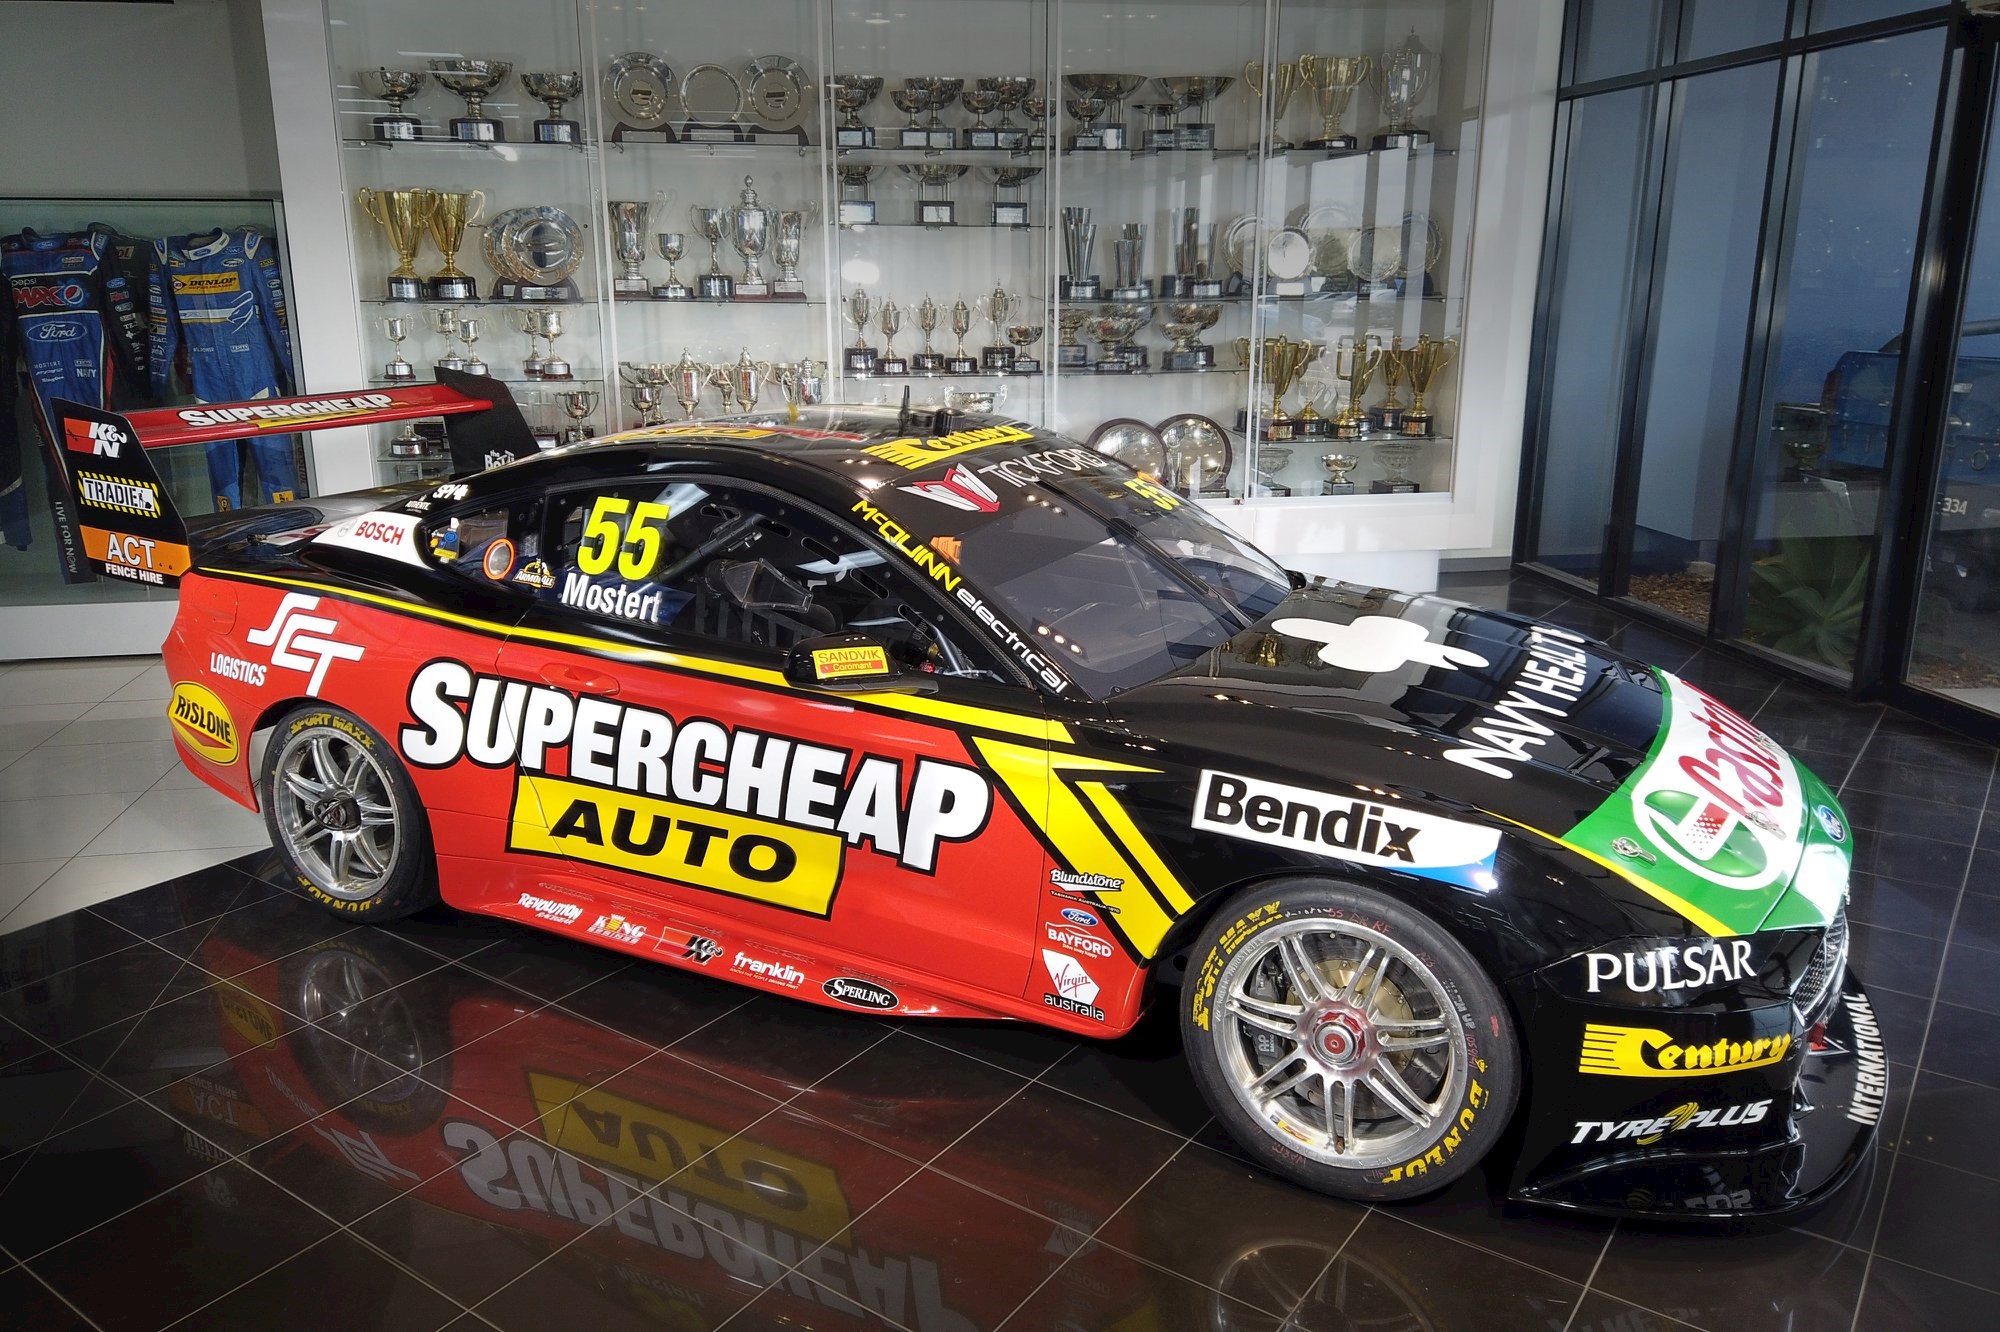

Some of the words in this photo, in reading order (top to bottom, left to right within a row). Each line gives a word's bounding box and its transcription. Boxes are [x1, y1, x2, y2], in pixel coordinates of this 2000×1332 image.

[11, 278, 37, 288] pepsi
[12, 285, 66, 309] MAX
[188, 277, 236, 287] DUNLOP
[39, 322, 77, 339] Ford
[76, 367, 97, 378] NAVY
[178, 394, 392, 427] SUPERCHEAP
[489, 449, 500, 457] the
[977, 449, 1108, 488] TICKFORD
[84, 479, 139, 509] TRADIE
[404, 500, 431, 510] AUTHENTIC
[54, 501, 67, 522] LIVE
[62, 524, 73, 546] FOR
[354, 521, 405, 546] BOSCH
[577, 496, 670, 581] 55
[106, 533, 155, 568] ACT
[104, 562, 139, 580] FENCE
[139, 569, 164, 585] HIRE
[561, 572, 663, 623] Mostert
[956, 588, 1067, 693] electrical
[210, 652, 267, 687] LOGISTICS
[818, 649, 881, 664] SANDVIK
[832, 660, 873, 672] Coromant
[333, 715, 375, 749] MAXX
[1443, 690, 1556, 780] NAVY
[1678, 679, 1785, 816] Castrol
[400, 660, 990, 872] SUPERCHEAP
[1203, 774, 1421, 864] Bendix
[548, 799, 797, 883] AUTO
[1050, 868, 1124, 889] Blundstone
[518, 892, 584, 920] REVOLUTION
[1067, 911, 1091, 926] Ford
[585, 924, 641, 945] SPRINGS
[1048, 928, 1112, 958] BAYFORD
[732, 951, 805, 985] franklin
[1054, 963, 1092, 998] Virgin
[1586, 940, 1757, 993] PULSAR
[829, 978, 891, 1007] SPERLING
[1044, 994, 1105, 1022] australia
[1578, 1023, 1791, 1078] Century
[1841, 993, 1886, 1126] INTERNATIONAL
